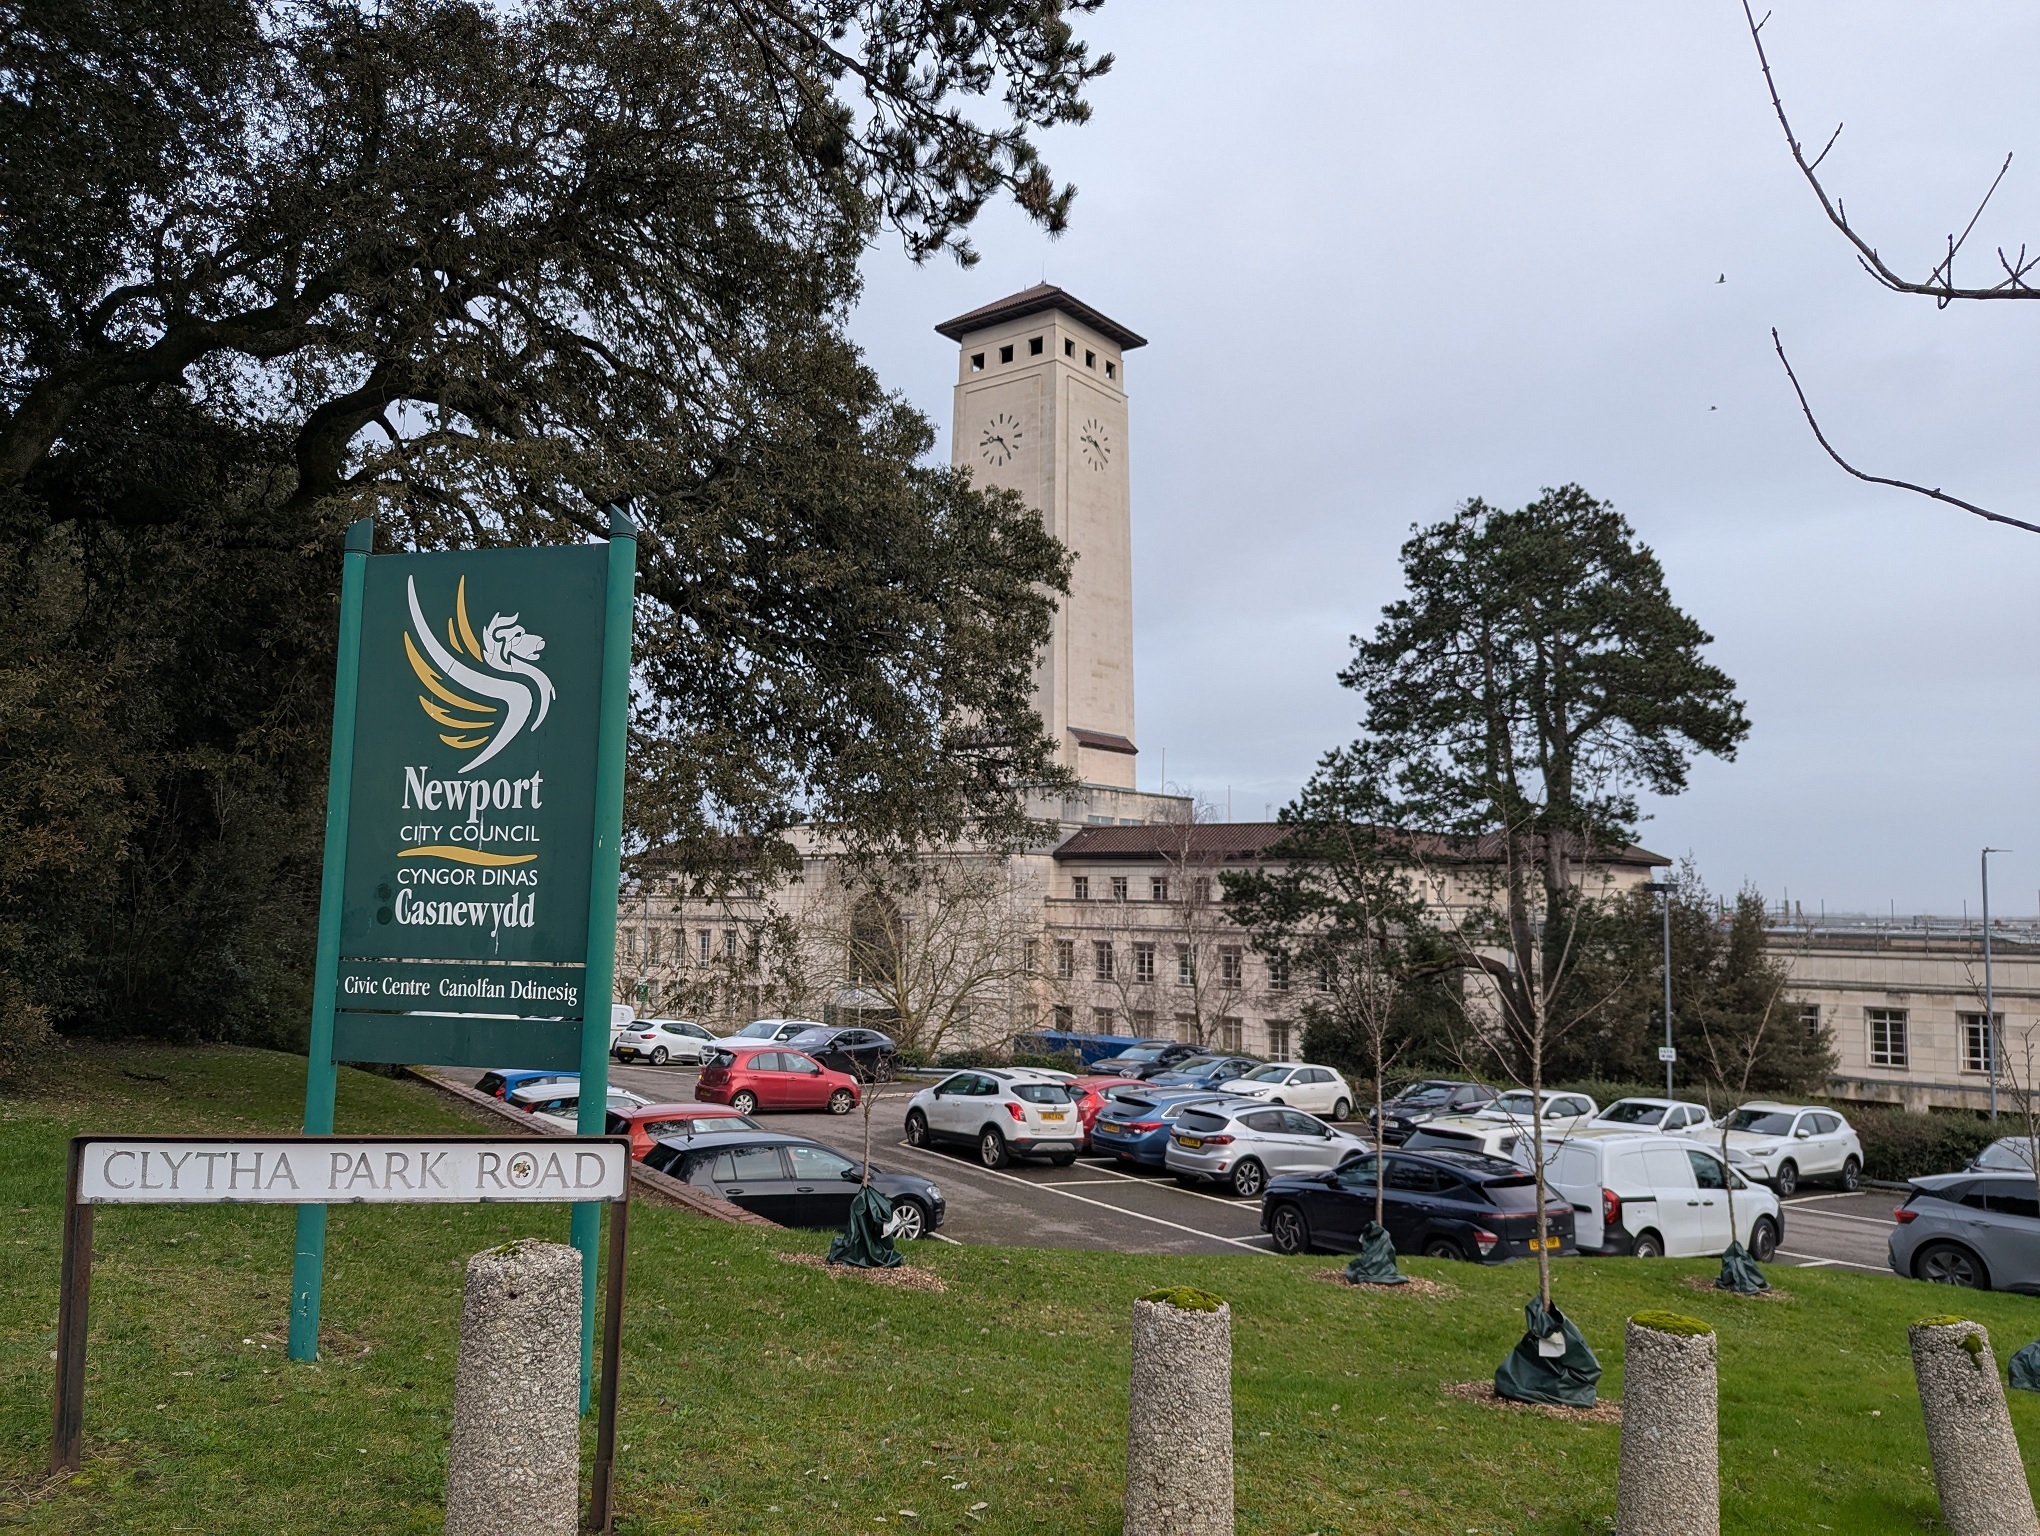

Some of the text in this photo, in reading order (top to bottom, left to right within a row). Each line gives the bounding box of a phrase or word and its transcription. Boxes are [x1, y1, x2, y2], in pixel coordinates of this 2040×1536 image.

[402, 766, 543, 823] Newport
[400, 825, 540, 842] CITY COUNCIL
[397, 868, 538, 887] CYNGOR DINAS
[395, 888, 535, 937] Casnewydd
[344, 976, 578, 1007] Civic Centre Canolfan Ddinesig
[103, 1151, 606, 1191] CLYTHA PARK ROAD
